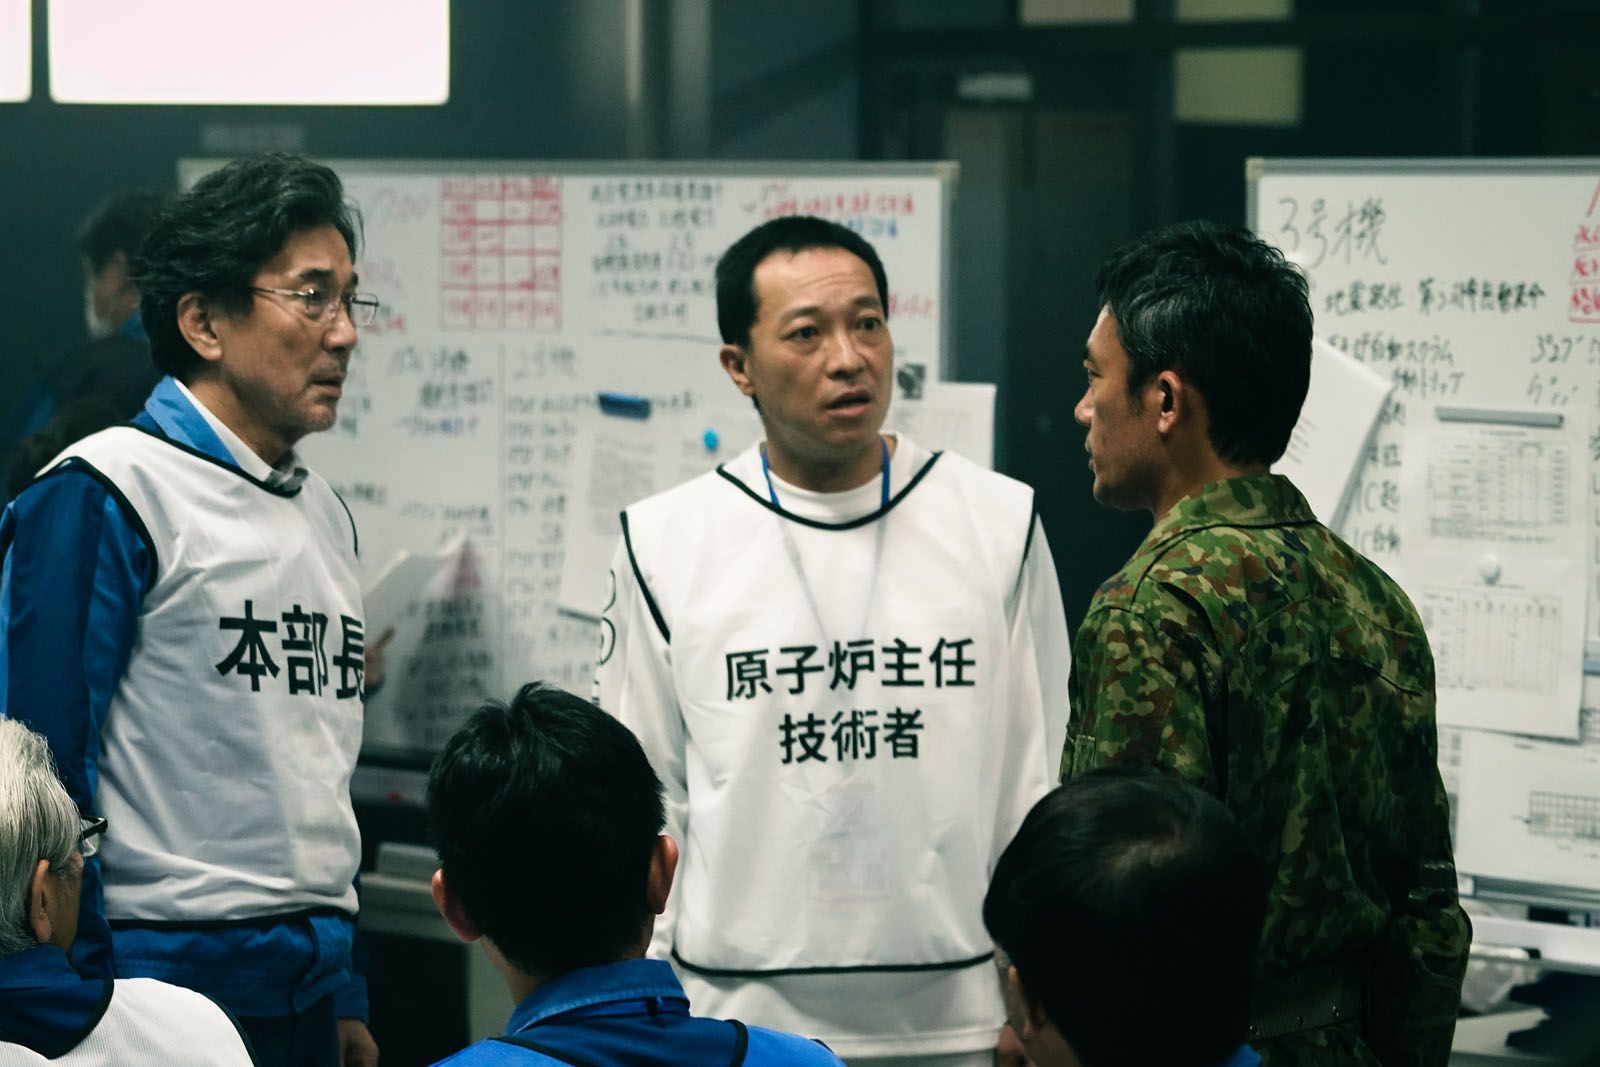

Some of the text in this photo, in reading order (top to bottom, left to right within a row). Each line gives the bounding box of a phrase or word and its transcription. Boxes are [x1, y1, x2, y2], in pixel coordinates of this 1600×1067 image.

[1278, 197, 1389, 270] 3号機
[215, 599, 365, 704] 本部長
[725, 637, 976, 701] 原子炉主任
[778, 706, 924, 765] 技術者
